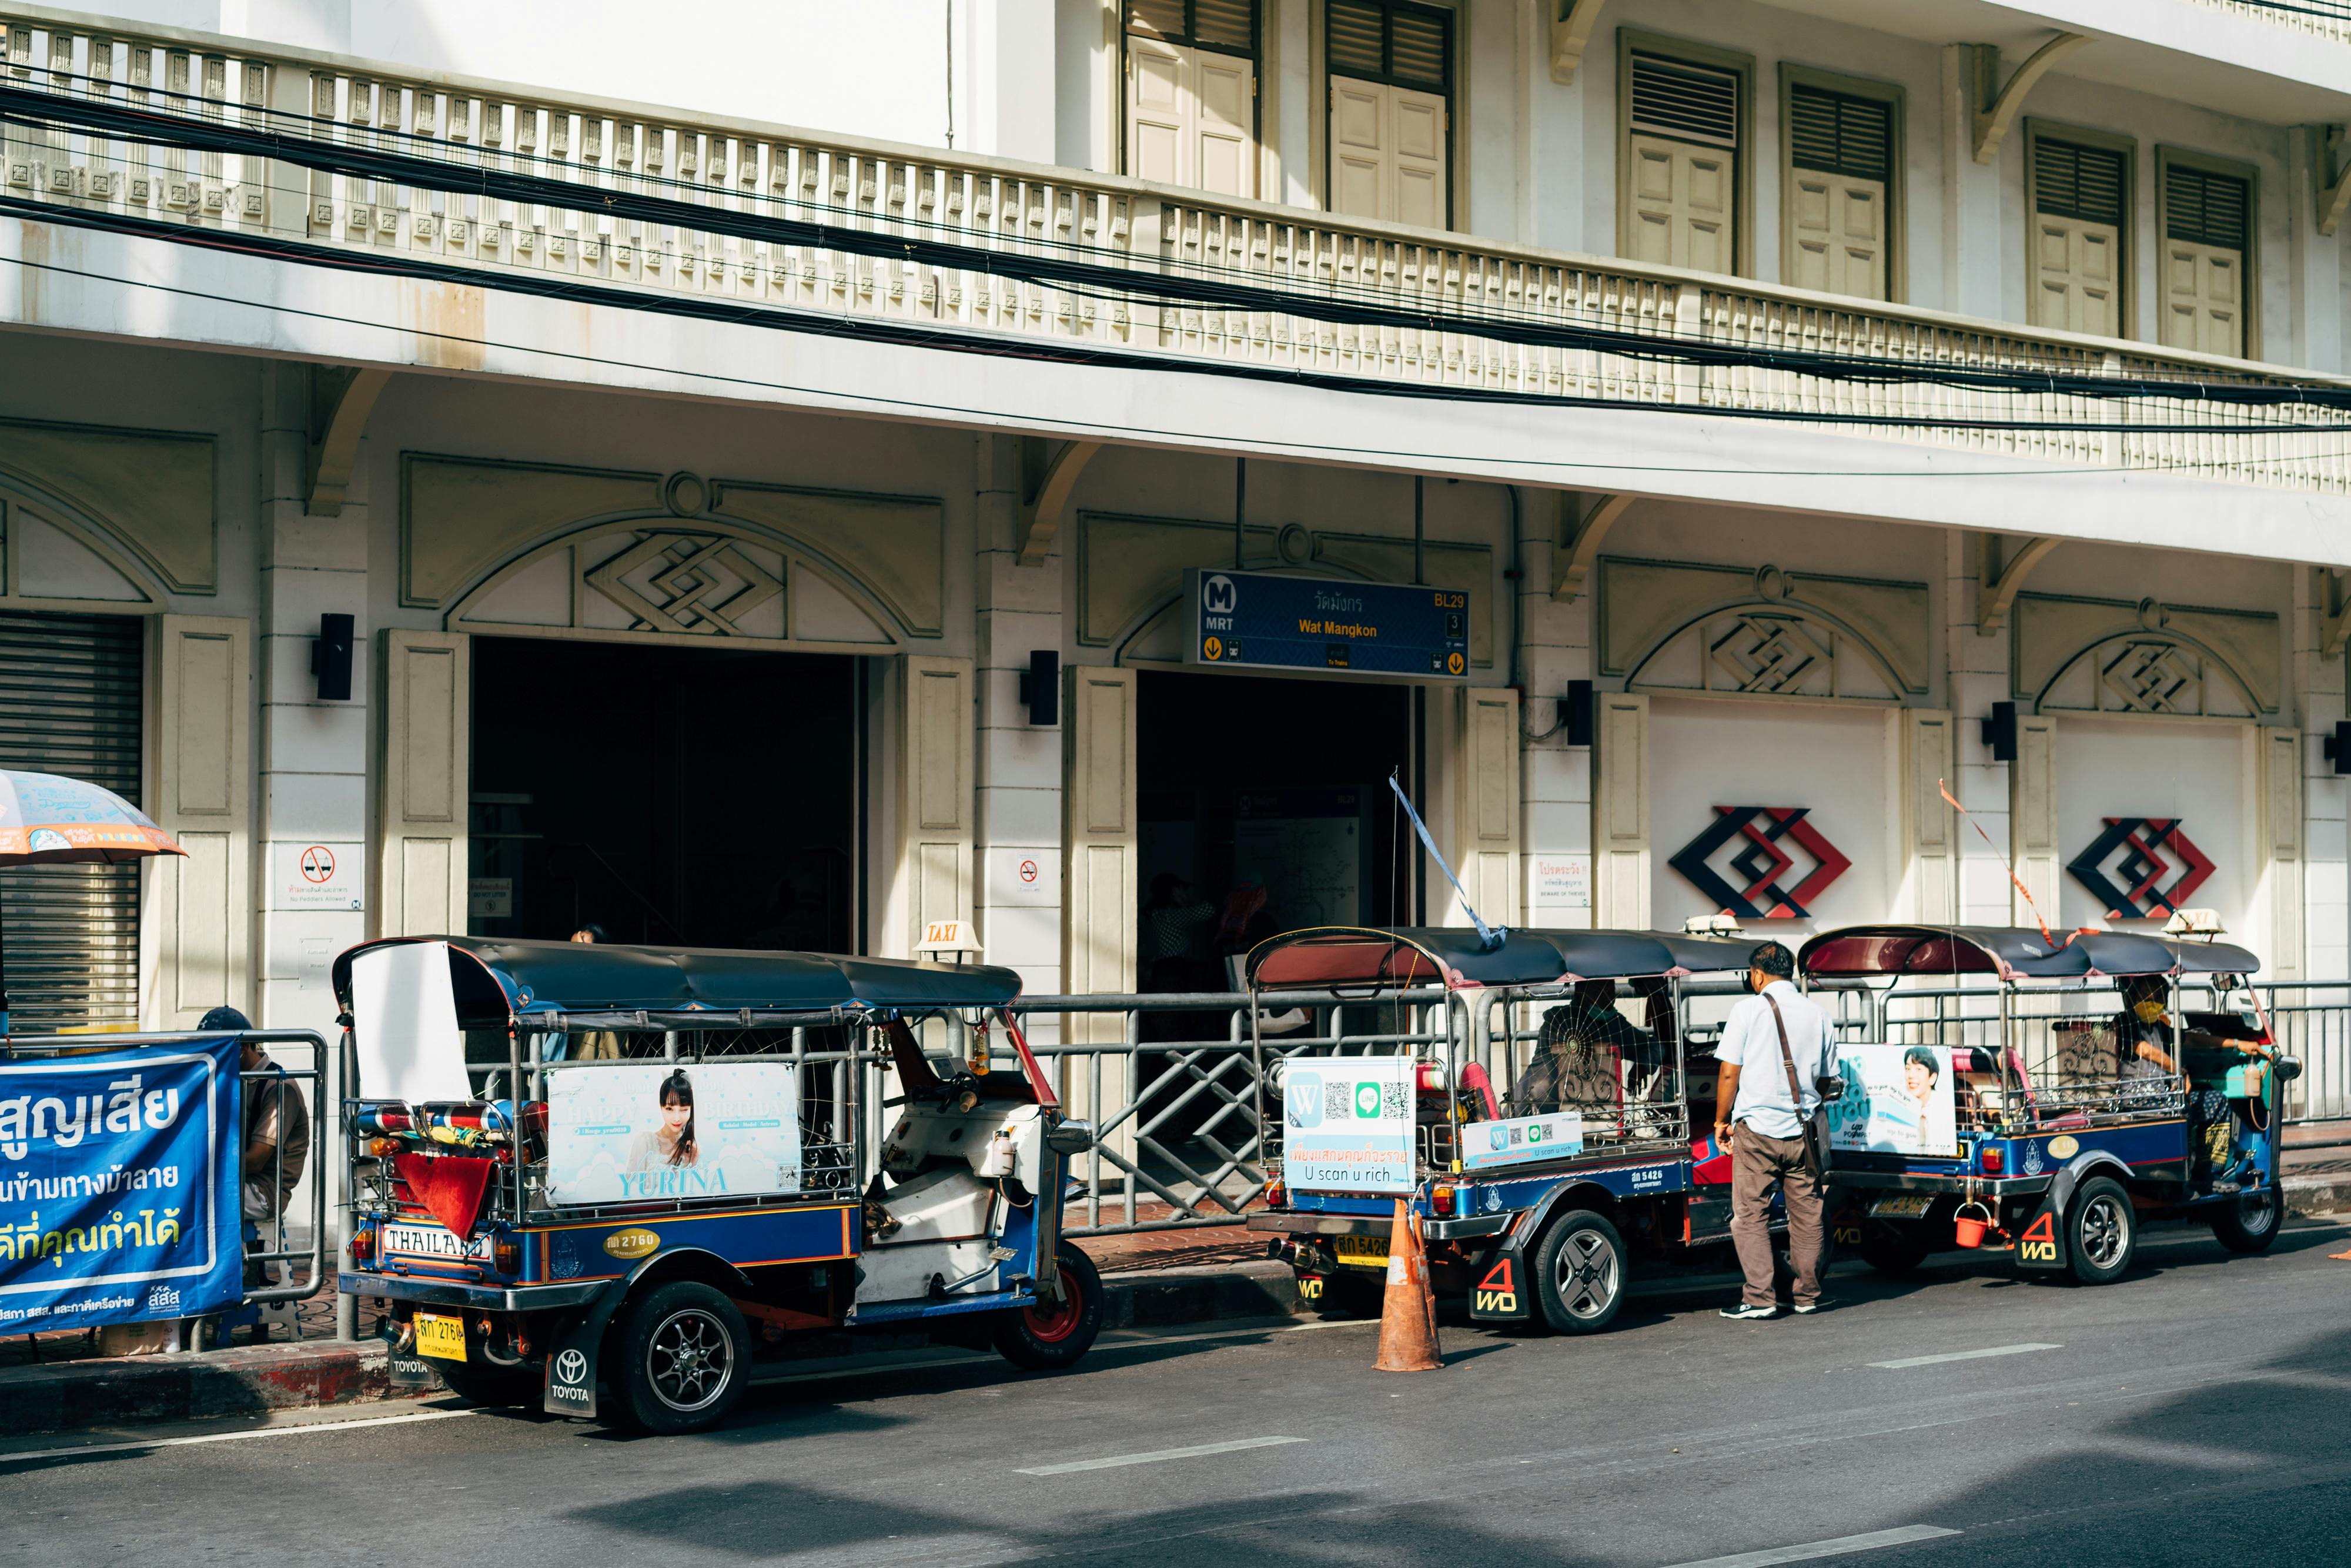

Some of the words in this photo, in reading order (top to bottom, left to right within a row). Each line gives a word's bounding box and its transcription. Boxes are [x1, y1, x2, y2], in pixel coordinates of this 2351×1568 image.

[1315, 590, 1363, 613] วัดมังกร
[1434, 593, 1464, 609] BL29
[1206, 617, 1234, 631] MRT
[1299, 619, 1322, 634] Wat
[1325, 621, 1377, 638] Mangkon
[1451, 615, 1459, 629] 3
[927, 924, 958, 942] TAXI
[0, 1074, 179, 1161] สูญเสีย
[566, 1103, 638, 1125] HAPPY
[704, 1100, 792, 1121] BIRTHDAY
[1825, 1098, 1875, 1134] you
[618, 1167, 729, 1199] YURINA
[1305, 1166, 1314, 1181] U
[1319, 1169, 1348, 1181] scan
[1353, 1171, 1360, 1181] u
[1366, 1166, 1390, 1182] rich
[1642, 1170, 1663, 1181] 5426
[2022, 1212, 2055, 1243] 4
[390, 1230, 483, 1258] THAILAND
[622, 1234, 654, 1247] 2760
[1359, 1238, 1389, 1257] 5426
[2021, 1242, 2056, 1261] WD
[1477, 1258, 1514, 1293] 4
[1298, 1280, 1323, 1299] WD
[27, 1306, 52, 1318] สสส.
[54, 1296, 135, 1315] และภาคีเครือข่าย
[1477, 1290, 1517, 1312] WD
[439, 1322, 462, 1341] 2760
[393, 1360, 428, 1373] TOYOTA
[552, 1385, 589, 1402] TOYOTA
